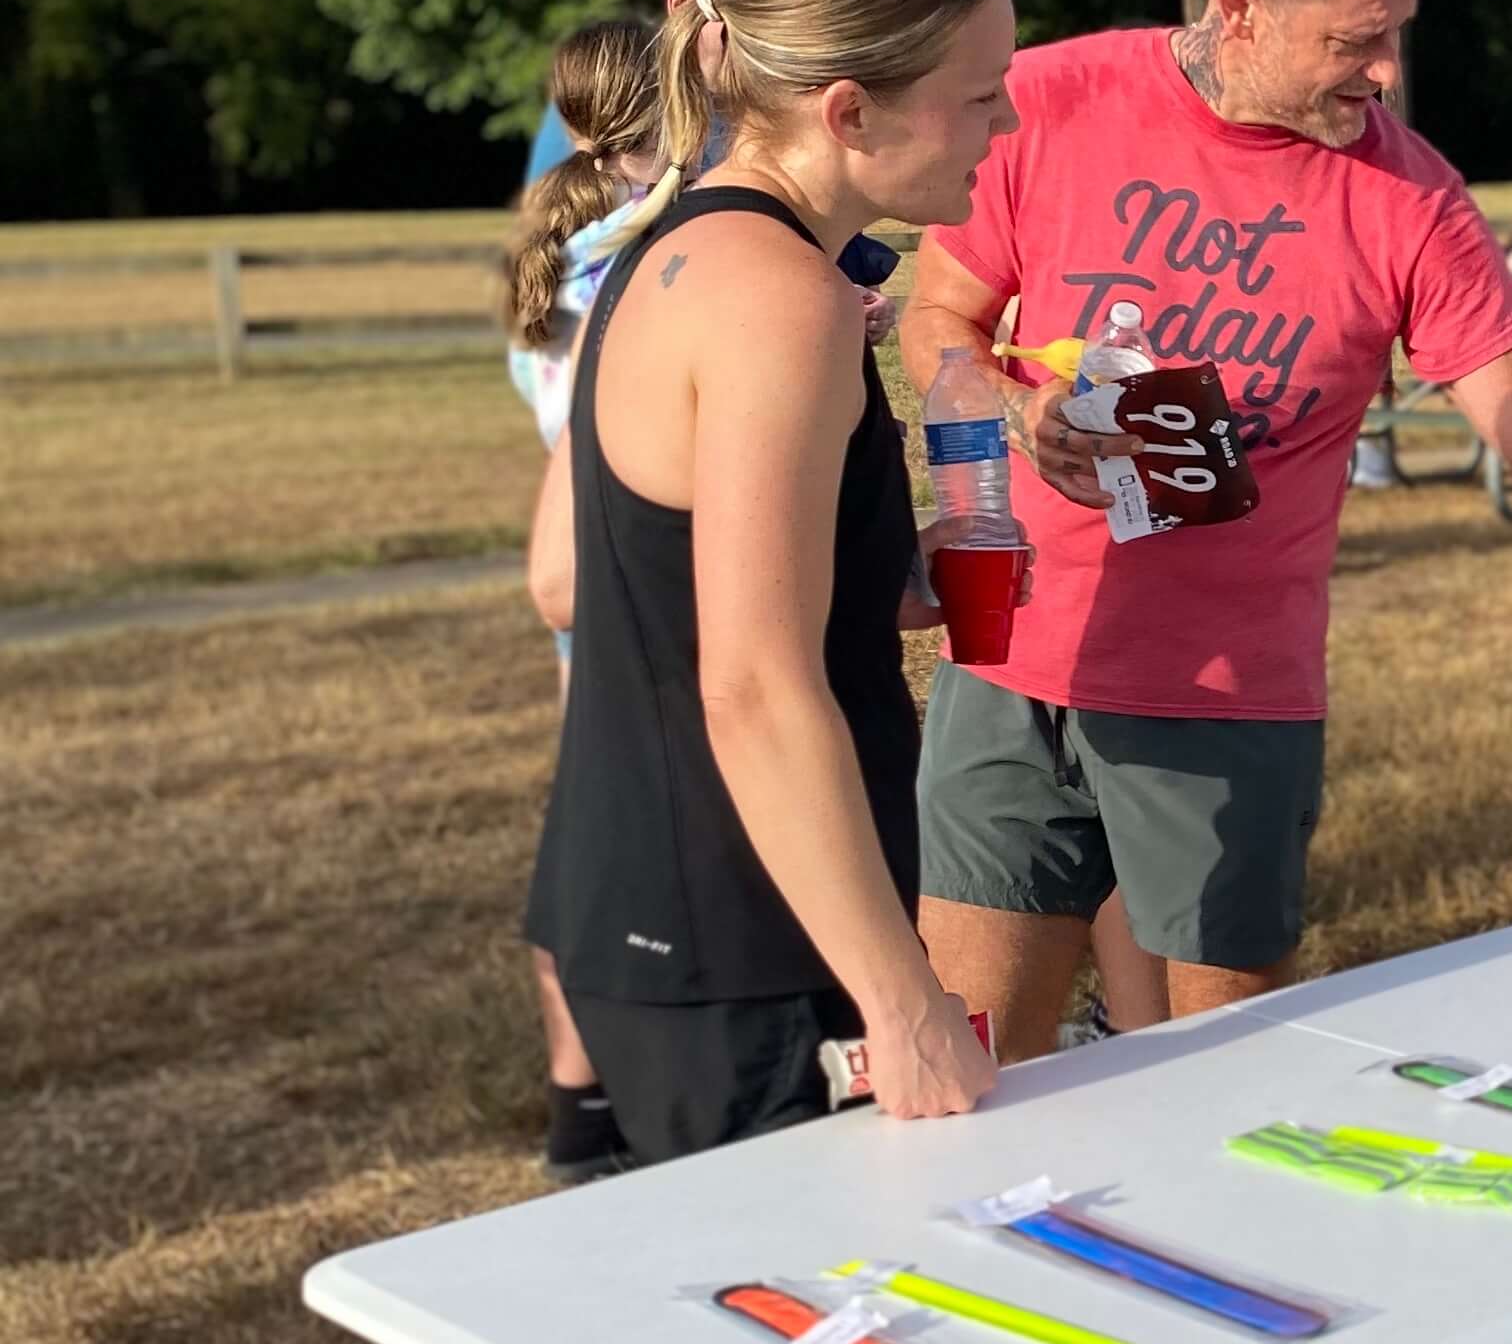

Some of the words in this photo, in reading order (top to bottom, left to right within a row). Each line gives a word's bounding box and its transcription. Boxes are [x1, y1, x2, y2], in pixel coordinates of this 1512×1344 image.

[1113, 179, 1305, 296] Not
[1062, 272, 1315, 407] Tday
[1126, 404, 1217, 493] 919
